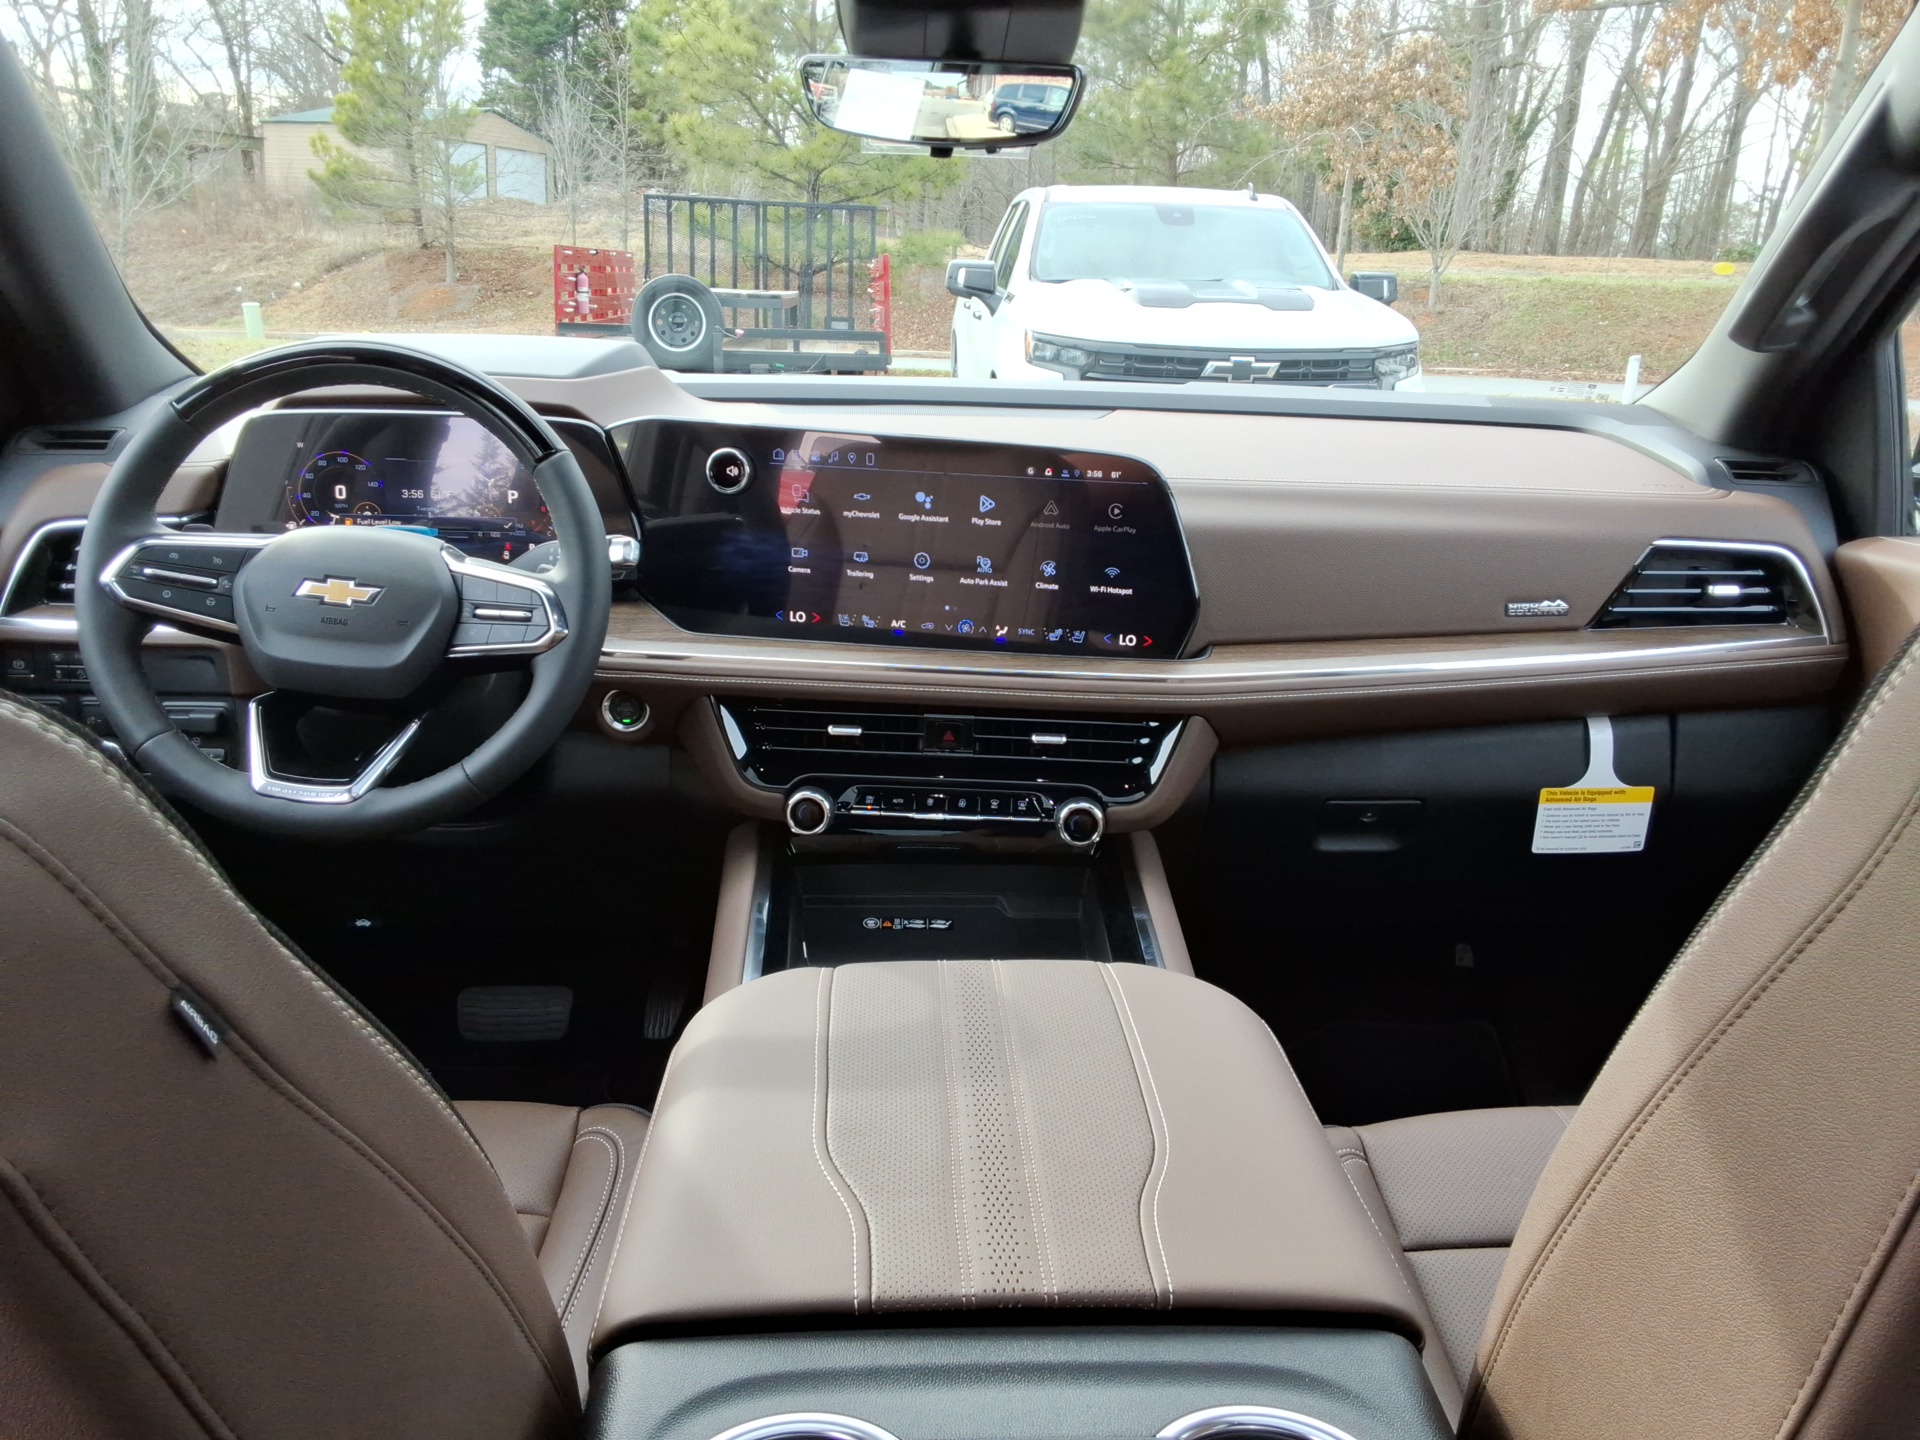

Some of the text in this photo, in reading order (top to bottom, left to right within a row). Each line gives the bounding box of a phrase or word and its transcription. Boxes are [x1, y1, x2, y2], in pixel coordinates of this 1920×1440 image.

[1086, 470, 1103, 478] 3:56
[334, 484, 347, 499] 0
[401, 489, 424, 499] 3:56
[507, 490, 519, 504] P
[802, 507, 821, 515] Status
[843, 510, 880, 519] myChevrolet
[898, 513, 949, 523] Google Assistant
[971, 517, 1002, 526] Play Store
[1030, 521, 1054, 529] Android
[1093, 525, 1137, 534] Apple CarPlay
[787, 565, 811, 574] Camera
[846, 569, 874, 579] Trailering
[908, 573, 934, 583] Settings
[959, 577, 1008, 587] Auto Park Assist
[1035, 581, 1059, 590] Climate
[1089, 585, 1133, 596] Wi-Fi Hotspot
[320, 616, 348, 626] AIRBAG
[788, 610, 806, 623] LO
[890, 619, 906, 628] A/C
[1017, 628, 1036, 636] SYNC
[1118, 633, 1137, 647] LO
[1586, 789, 1613, 797] Equipped
